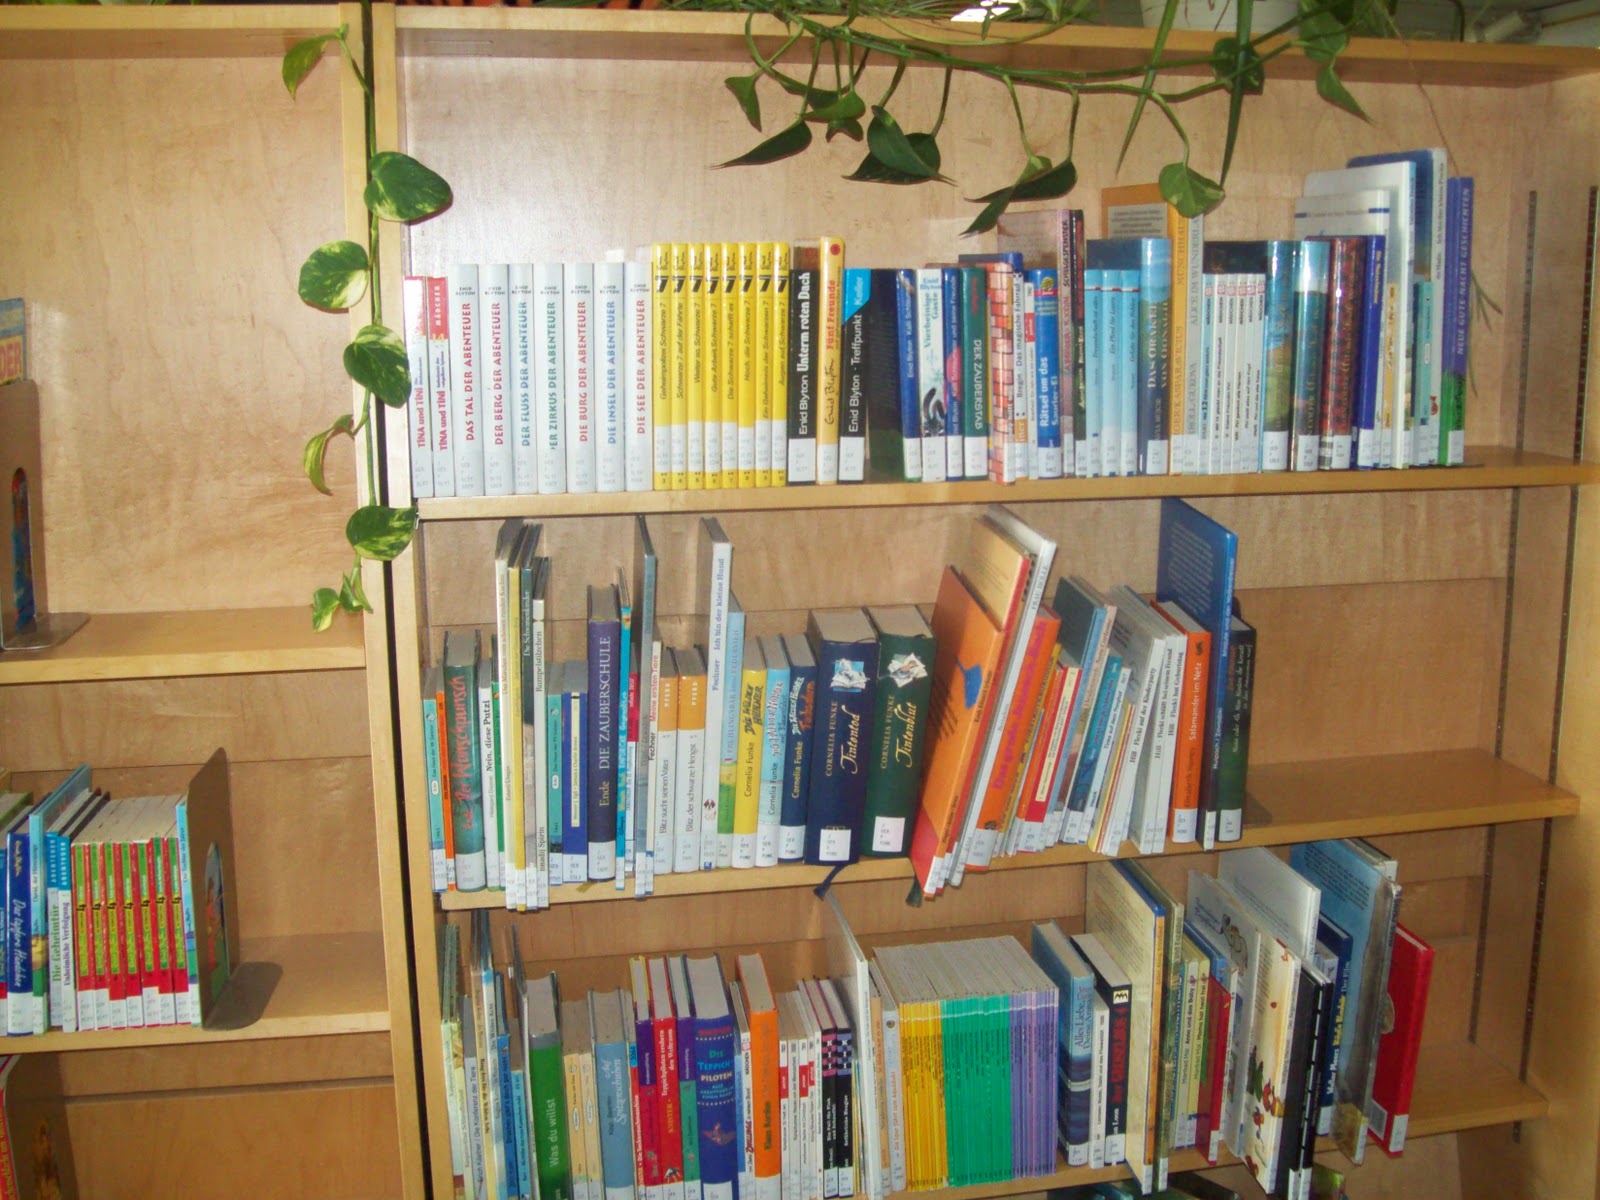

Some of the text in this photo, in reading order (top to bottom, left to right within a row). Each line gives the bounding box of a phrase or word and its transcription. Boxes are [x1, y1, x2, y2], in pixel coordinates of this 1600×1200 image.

[1459, 189, 1470, 258] GESCHICHTEN
[827, 280, 835, 349] Fünf Freunde
[1013, 283, 1021, 313] Fahrrad
[519, 302, 528, 364] ABENTEUER
[547, 303, 556, 364] ABENTEUER
[578, 301, 586, 363] ABENTEUER
[607, 301, 615, 364] ABENTEUER
[852, 314, 862, 365] Treffpunkt
[1014, 315, 1023, 351] magische
[1457, 328, 1465, 354] NEUE
[462, 303, 474, 440] DAS TAL DER ABENTEUER
[637, 299, 645, 434] DIE SEE DER ABENTEUER
[797, 271, 810, 434] Enid Blyton Unterm roten Dach
[492, 303, 503, 445] DER BERG DER ABENTEUER
[520, 369, 528, 388] DER
[548, 368, 556, 388] DER
[578, 368, 586, 387] DER
[607, 369, 615, 389] DER
[660, 347, 668, 399] Geheimpolizei
[825, 358, 837, 424] Enid Blyton
[850, 374, 861, 406] Blyton
[974, 339, 983, 429] DER ZAUBERSTAB
[1039, 356, 1049, 426] Rätsel um das
[438, 411, 446, 427] und
[520, 393, 529, 421] FLUSS
[549, 392, 557, 430] ZIRKUS
[579, 392, 587, 420] BURG
[607, 394, 615, 422] INSEL
[850, 409, 859, 432] Enid
[521, 426, 530, 446] DER
[608, 427, 616, 444] DIE
[716, 557, 724, 580] Hund
[715, 581, 723, 606] kleine
[713, 637, 721, 650] Ich
[714, 623, 722, 636] bin
[712, 659, 720, 690] Fechner
[1143, 667, 1156, 703] Kinderparty
[482, 700, 491, 725] Putzi
[1189, 662, 1201, 740] Salamander im Netz
[599, 635, 611, 806] Ende DIE ZAUBERSCHULE
[826, 701, 838, 776] CORNELIA FUNKE
[841, 704, 860, 774] Tintentod
[880, 693, 895, 769] CORNELIA FUNKE
[894, 701, 916, 767] Tintenblut
[689, 743, 698, 768] Hengst
[744, 742, 754, 797] Cornelia Funke
[792, 741, 803, 798] Cornelia Funke
[687, 769, 695, 801] schwarze
[768, 762, 778, 815] Cornelia Funke
[62, 903, 70, 940] Verfolgung
[50, 904, 61, 982] Die Geheimtür
[701, 1072, 732, 1082] PILOTEN
[547, 1098, 559, 1167] Was du willst
